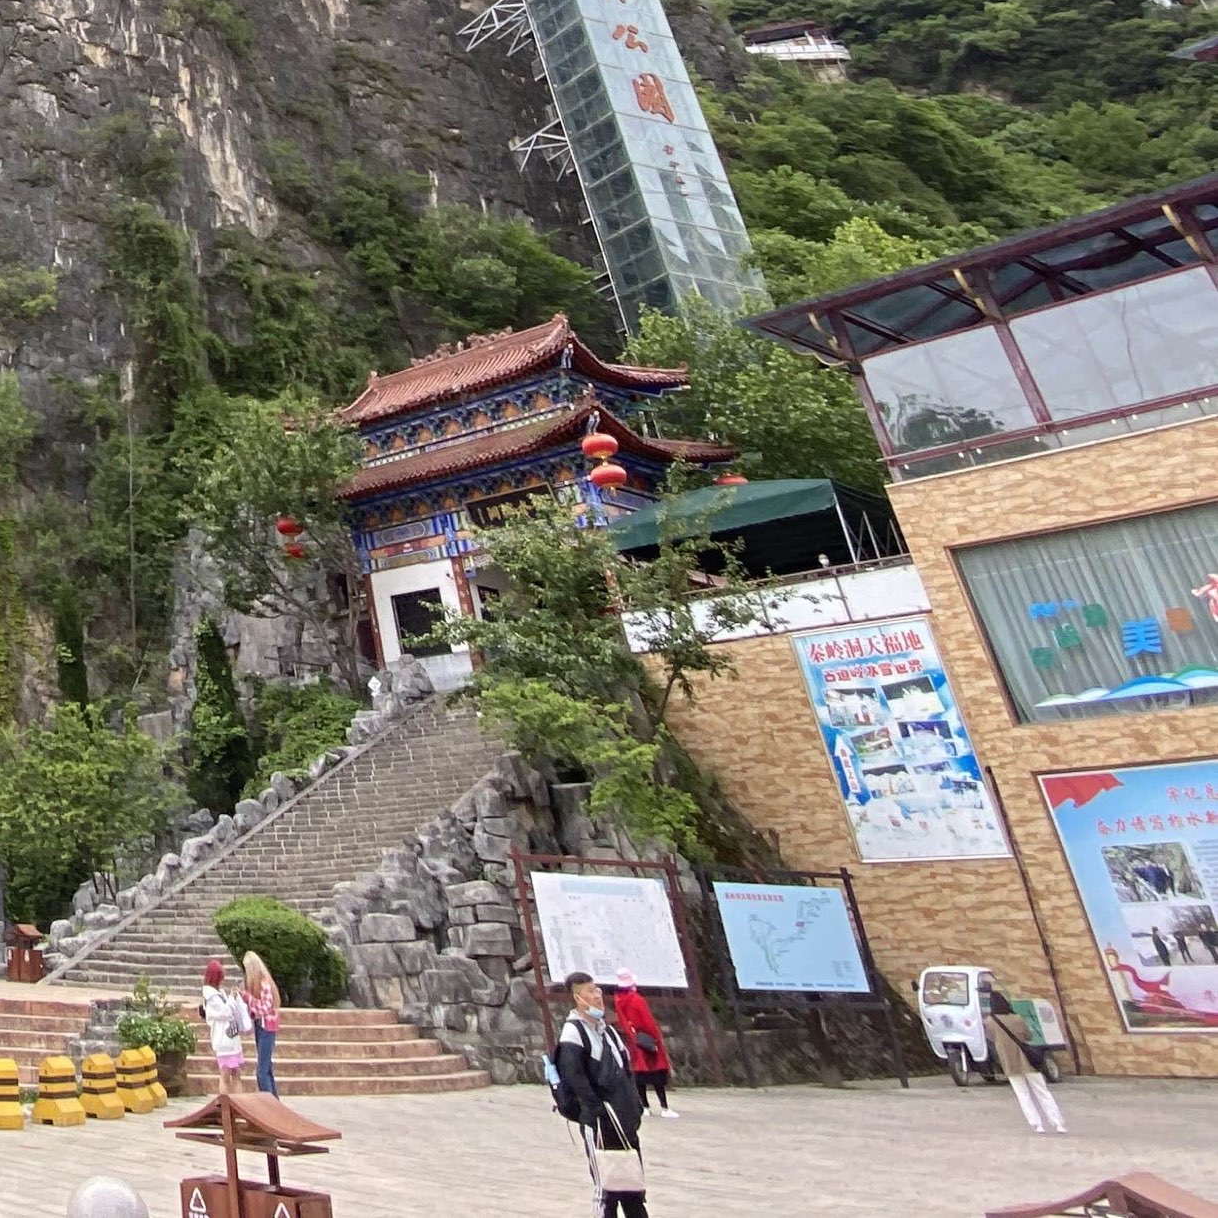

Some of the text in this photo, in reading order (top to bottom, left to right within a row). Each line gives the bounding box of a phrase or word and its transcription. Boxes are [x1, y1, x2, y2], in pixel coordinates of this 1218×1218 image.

[809, 629, 924, 663] 秦岭洞天福地
